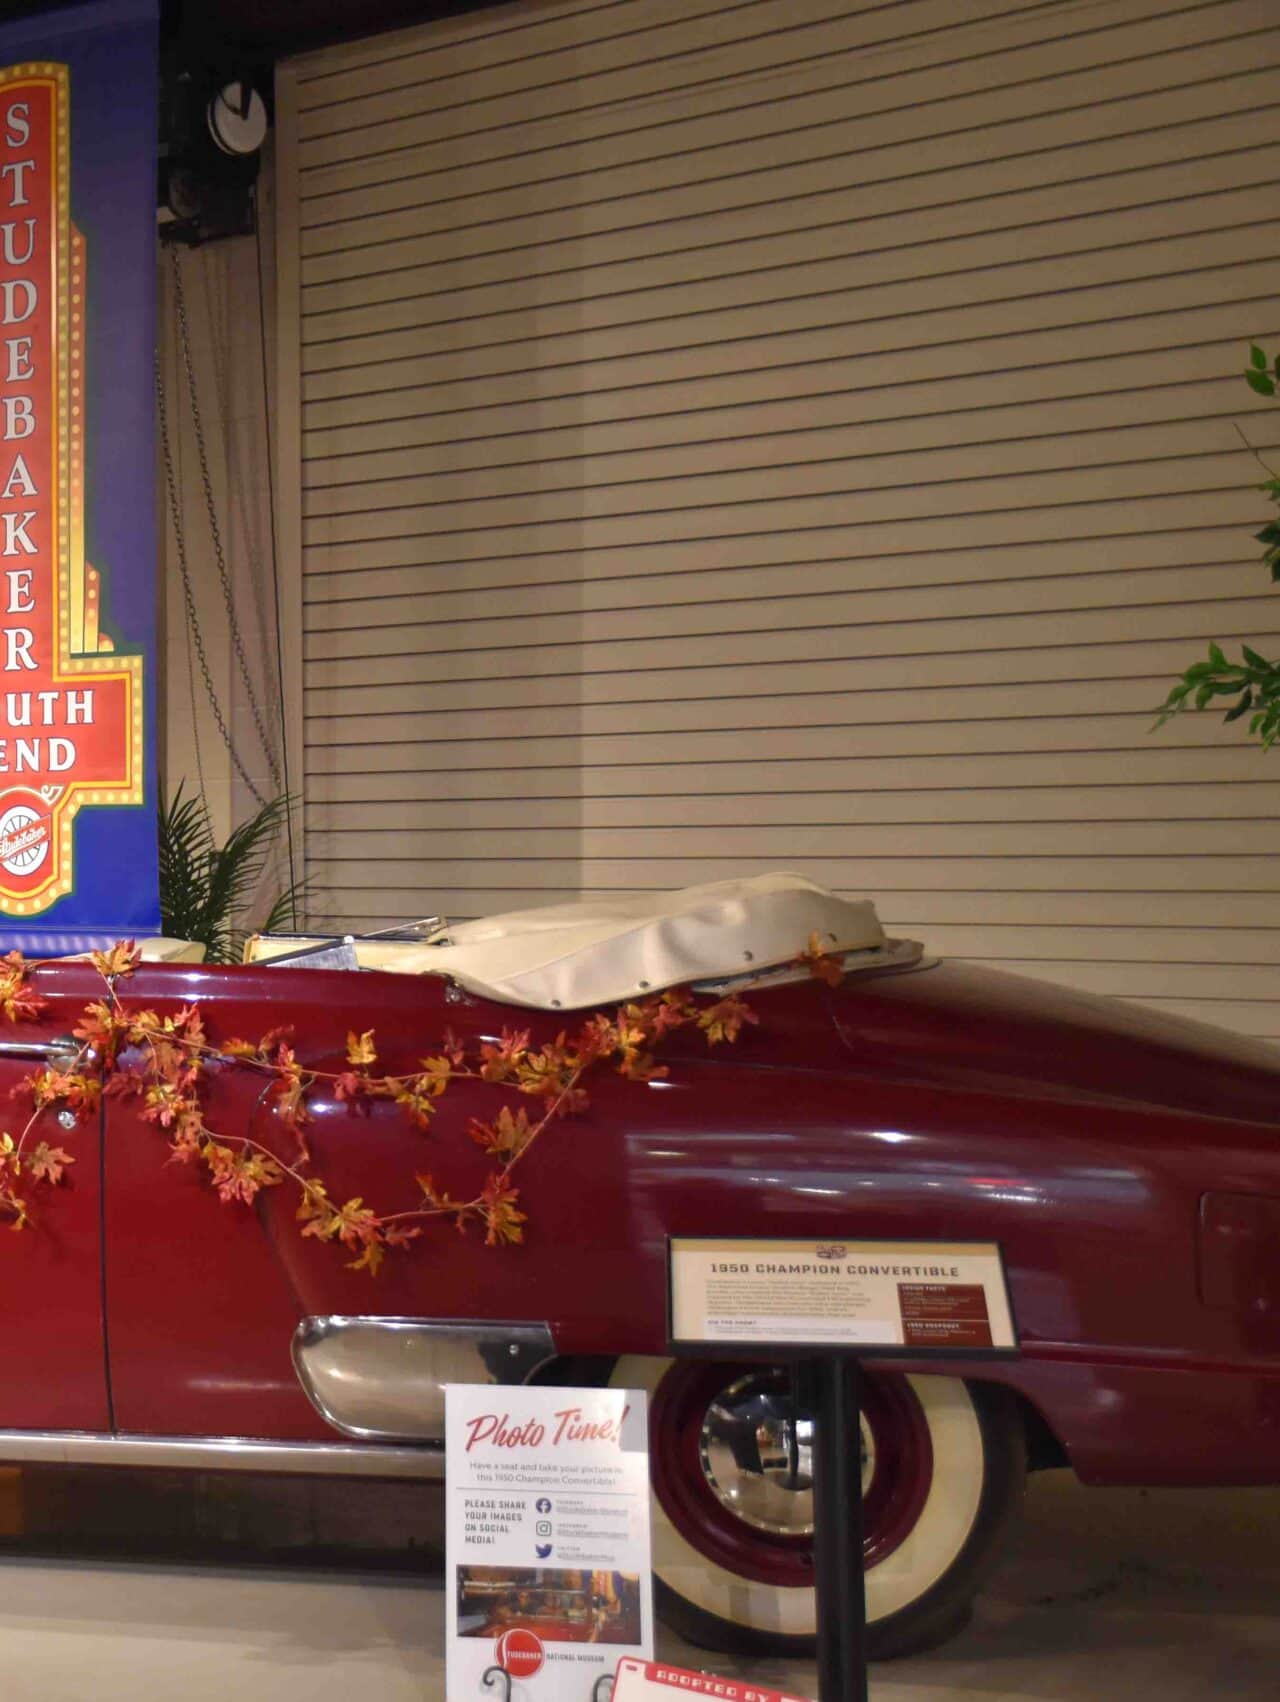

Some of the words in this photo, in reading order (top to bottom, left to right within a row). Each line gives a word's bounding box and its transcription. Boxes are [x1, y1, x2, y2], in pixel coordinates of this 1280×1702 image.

[0, 103, 39, 672] STUDEBAKER
[711, 1263, 750, 1273] 1950
[755, 1263, 840, 1275] CHAMPION
[847, 1265, 959, 1277] CONVERTIBLE
[465, 1413, 545, 1452] Photo
[552, 1405, 630, 1447] Time!
[469, 1462, 491, 1470] Have
[501, 1463, 518, 1471] seat
[520, 1463, 536, 1471] and
[539, 1464, 558, 1472] take
[559, 1466, 579, 1474] your
[581, 1465, 613, 1475] picture
[495, 1474, 514, 1482] 1950
[515, 1475, 559, 1485] Champion
[465, 1500, 496, 1508] PLEASE
[499, 1501, 526, 1509] SHARE
[465, 1511, 487, 1520] YOUR
[490, 1512, 522, 1521] IMAGES
[465, 1524, 477, 1532] ON
[480, 1524, 509, 1533] SOCIAL
[465, 1535, 495, 1544] MEDIA!
[656, 1670, 737, 1696] ADOPTED
